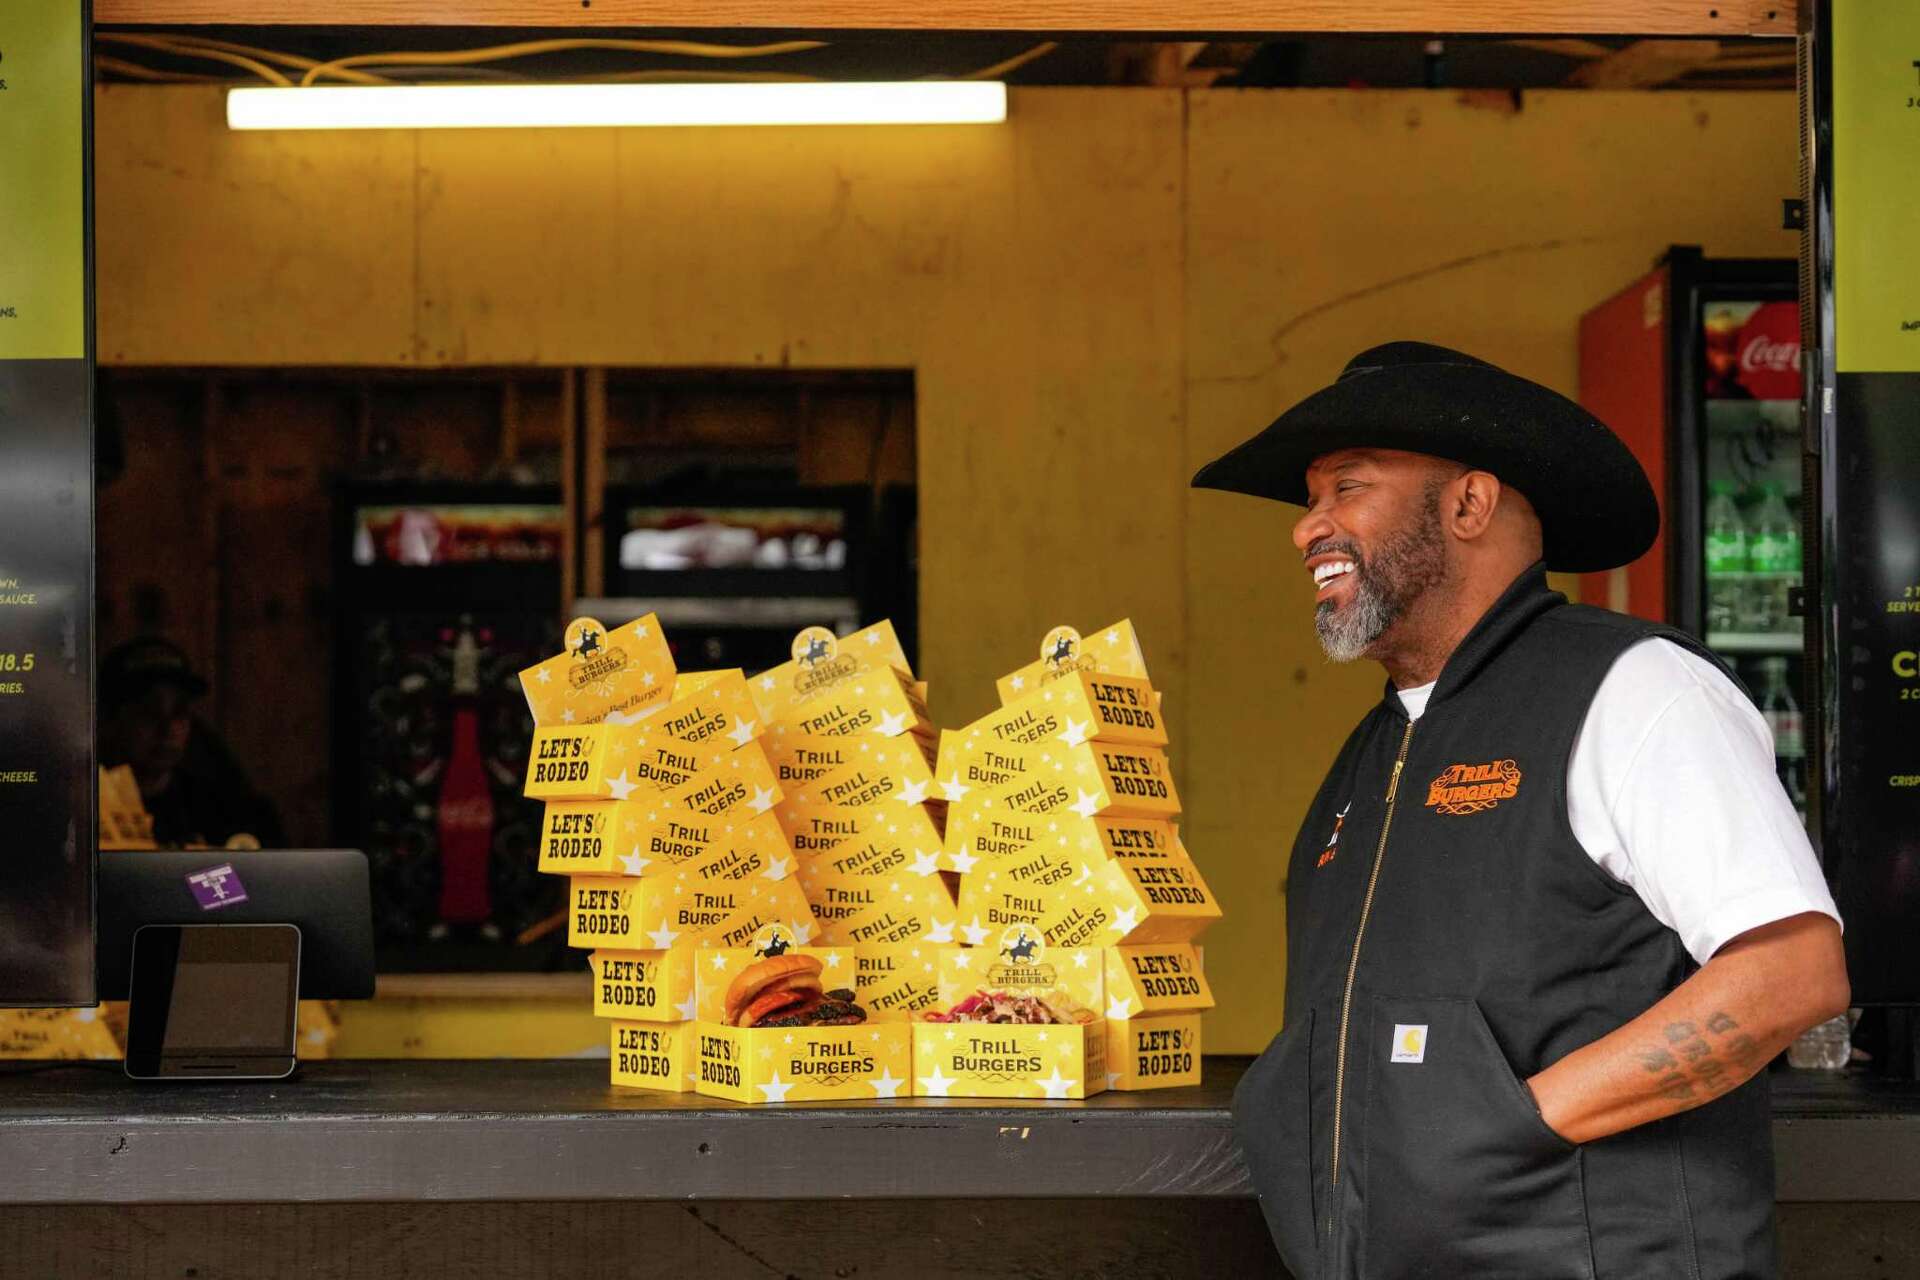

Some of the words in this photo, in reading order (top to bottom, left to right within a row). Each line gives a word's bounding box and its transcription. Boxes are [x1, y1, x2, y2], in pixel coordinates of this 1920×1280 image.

[578, 660, 621, 684] BURGERS
[582, 656, 613, 674] TRILL
[1892, 651, 1920, 678] C
[1091, 683, 1138, 706] LET'S
[663, 707, 706, 736] TRILL
[679, 713, 726, 743] GERS
[800, 705, 848, 735] TRILL
[819, 709, 872, 736] GERS
[993, 710, 1037, 740] TRILL
[1099, 705, 1155, 729] RODEO
[1010, 715, 1058, 744] GERS
[539, 737, 582, 759] LET'S
[795, 749, 845, 765] TRILL
[534, 761, 589, 783] RODEO
[656, 749, 698, 772] TRILL
[984, 751, 1027, 772] TRILL
[1103, 754, 1150, 775] LET'S
[1443, 760, 1504, 784] TRILL
[0, 771, 38, 782] HEESE.
[821, 772, 870, 802] TRILL
[1111, 775, 1168, 799] RODEO
[683, 779, 726, 810] TRILL
[699, 783, 746, 815] GERS
[838, 776, 894, 806] GERS
[1004, 781, 1048, 810] TRILL
[1022, 786, 1069, 814] GERS
[1425, 779, 1520, 806] BURGERS
[550, 814, 594, 834] LET'S
[668, 822, 710, 843] TRILL
[811, 818, 860, 834] TRILL
[992, 822, 1034, 842] TRILL
[548, 838, 602, 858] RODEO
[1107, 829, 1155, 849] LET'S
[699, 850, 741, 880] TRILL
[833, 844, 881, 875] TRILL
[1008, 854, 1052, 882] TRILL
[1132, 867, 1184, 884] LET'S
[577, 890, 619, 910] LET'S
[694, 893, 736, 908] TRILL
[826, 888, 875, 904] TRILL
[1003, 894, 1045, 913] TRILL
[1144, 887, 1206, 904] RODEO
[577, 914, 630, 935] RODEO
[722, 915, 764, 947] TRILL
[849, 913, 897, 943] TRILL
[1043, 908, 1084, 943] TRILL
[1061, 907, 1107, 948] RGERS
[602, 960, 644, 982] LET'S
[854, 956, 896, 971] RILL
[1132, 955, 1180, 975] LET'S
[997, 976, 1048, 985] BURGERS
[1141, 976, 1200, 997] RODEO
[602, 985, 656, 1007] RODEO
[869, 982, 918, 1011] TRILL
[619, 1029, 659, 1052] LET'S
[701, 1036, 730, 1061] LET'S
[807, 1040, 856, 1057] TRILL
[969, 1038, 1022, 1054] TRILL
[1138, 1030, 1181, 1052] LET'S
[618, 1053, 670, 1077] RODEO
[701, 1061, 740, 1087] RODEO
[791, 1057, 875, 1075] BURGERS
[953, 1055, 1042, 1072] BURGERS
[1138, 1053, 1192, 1076] RODEO
